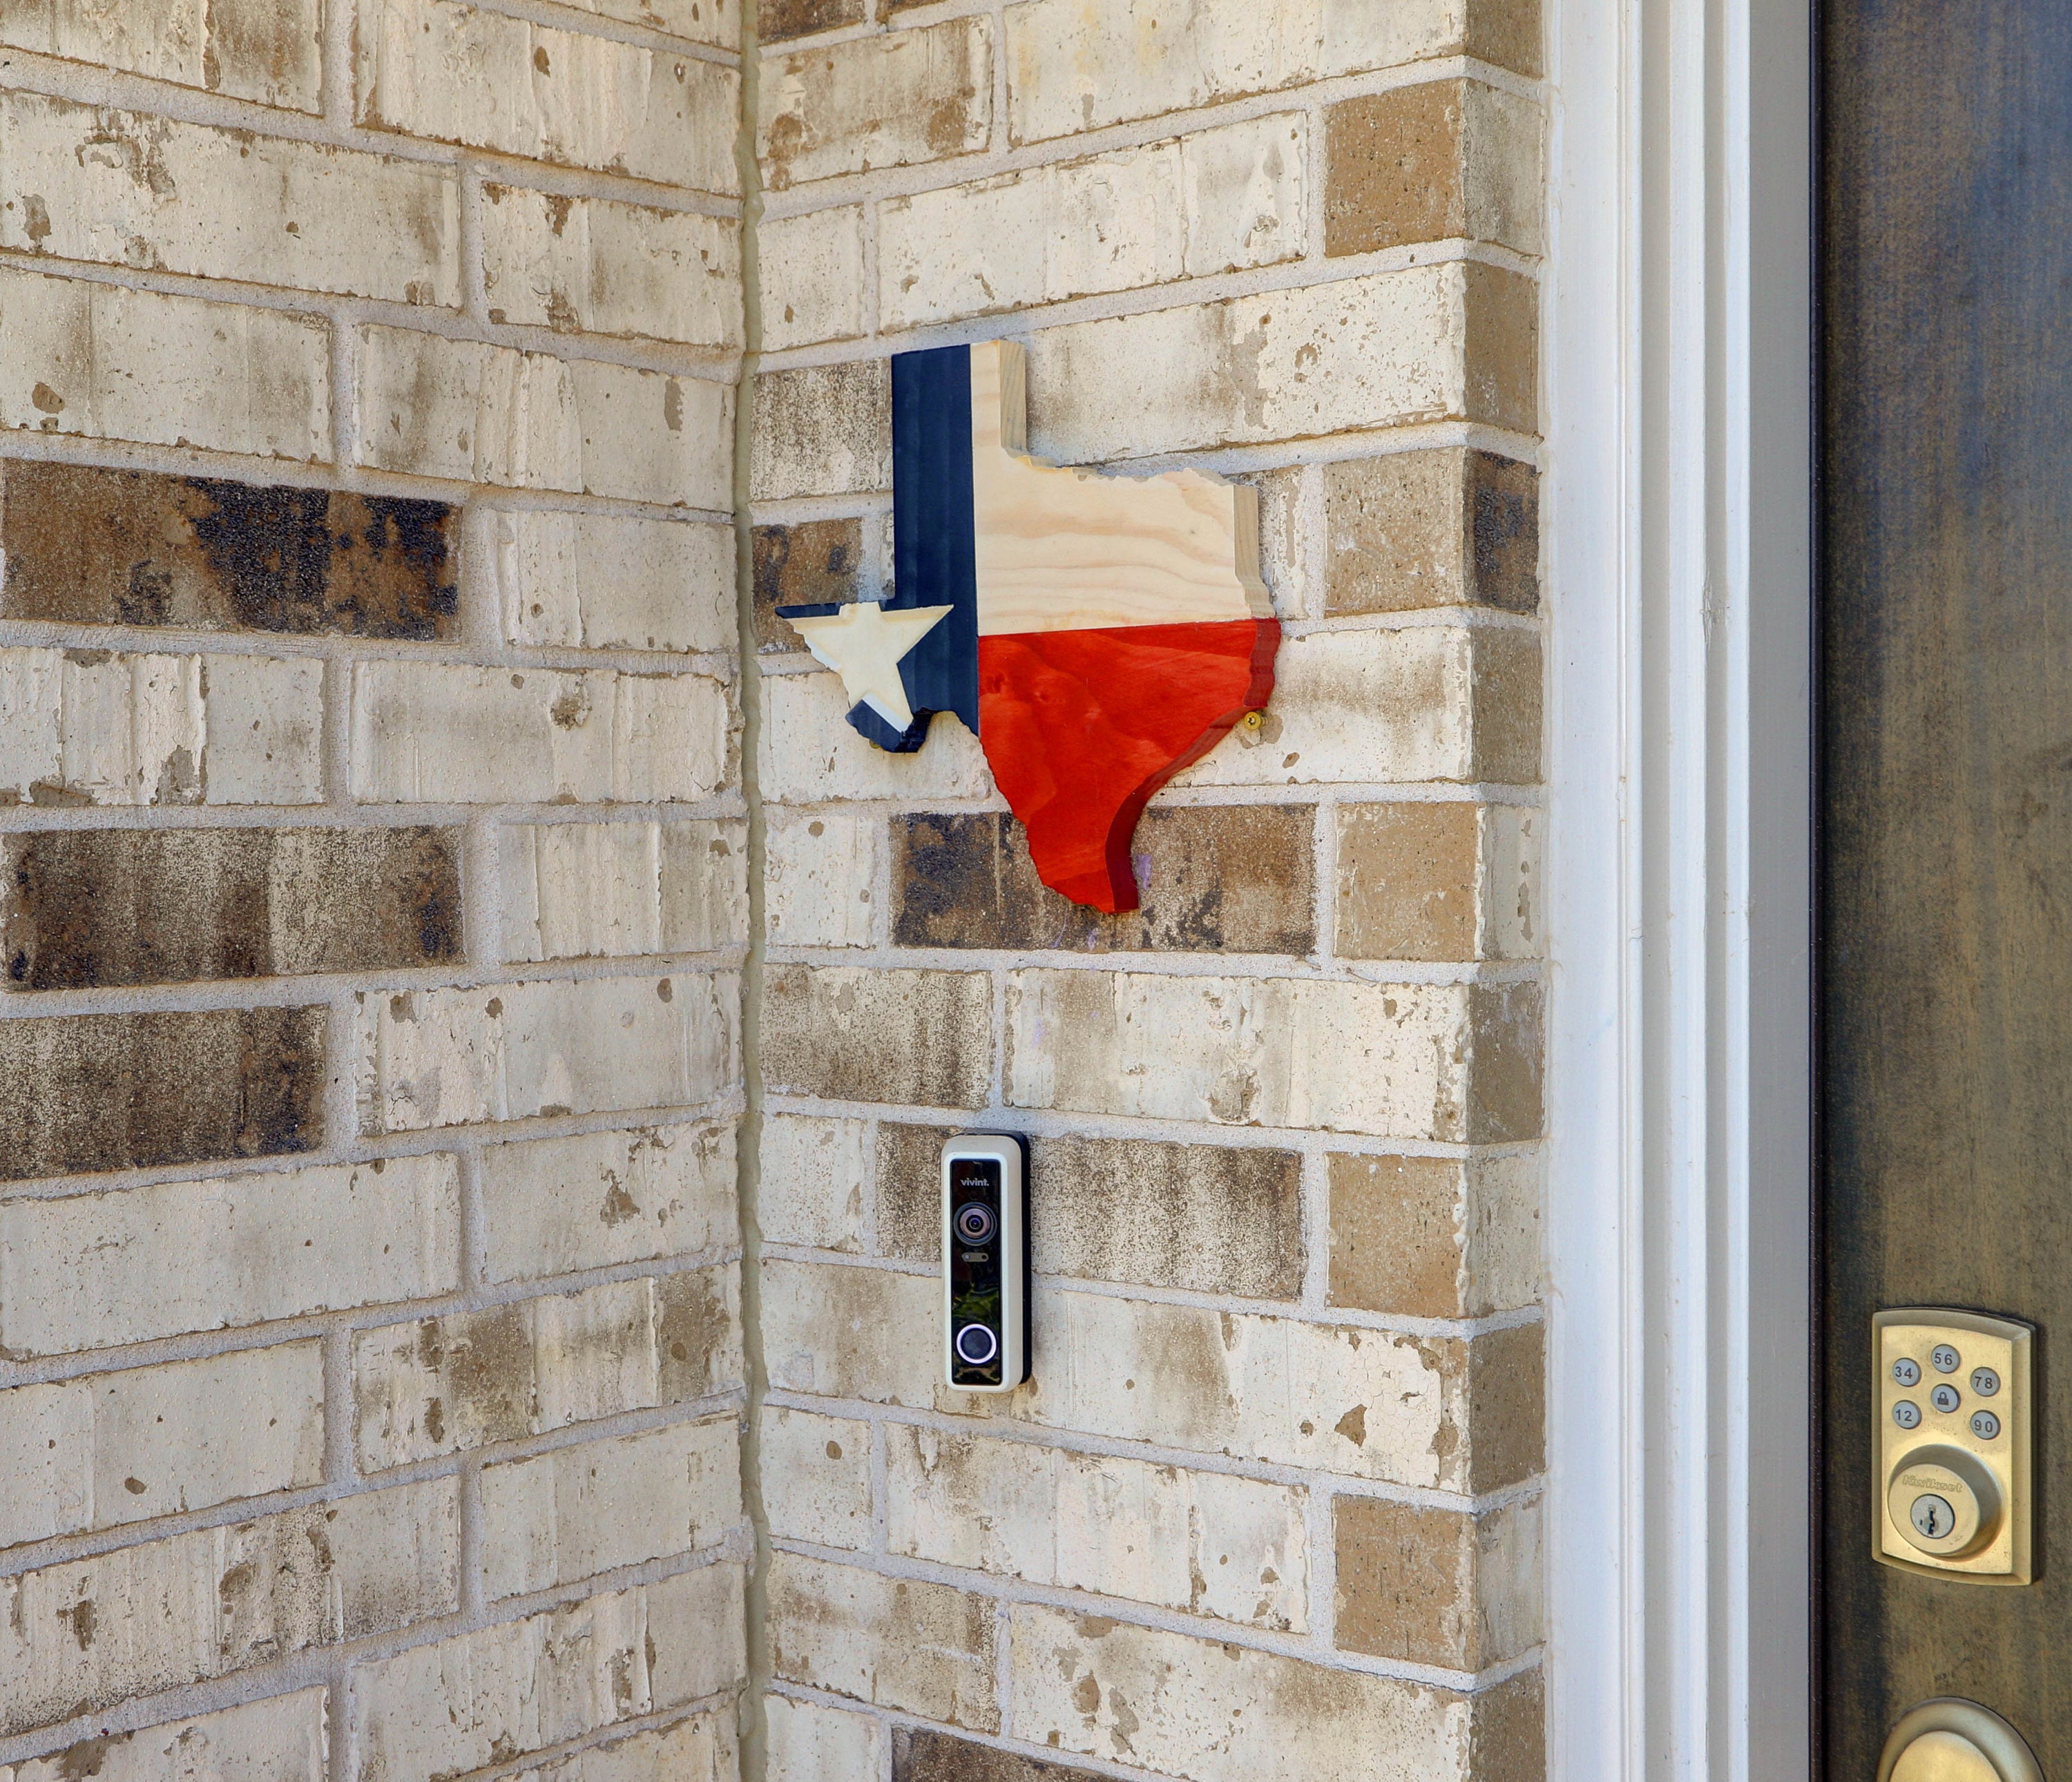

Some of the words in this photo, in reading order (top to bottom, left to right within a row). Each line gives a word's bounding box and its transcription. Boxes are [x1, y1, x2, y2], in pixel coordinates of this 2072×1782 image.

[960, 1178, 990, 1187] vivint.
[1934, 1352, 1953, 1366] 56
[1894, 1366, 1913, 1379] 34
[1974, 1376, 1993, 1389] 78
[1895, 1409, 1912, 1422] 12
[1974, 1419, 1993, 1433] 90
[1902, 1475, 1963, 1493] Kwikset
